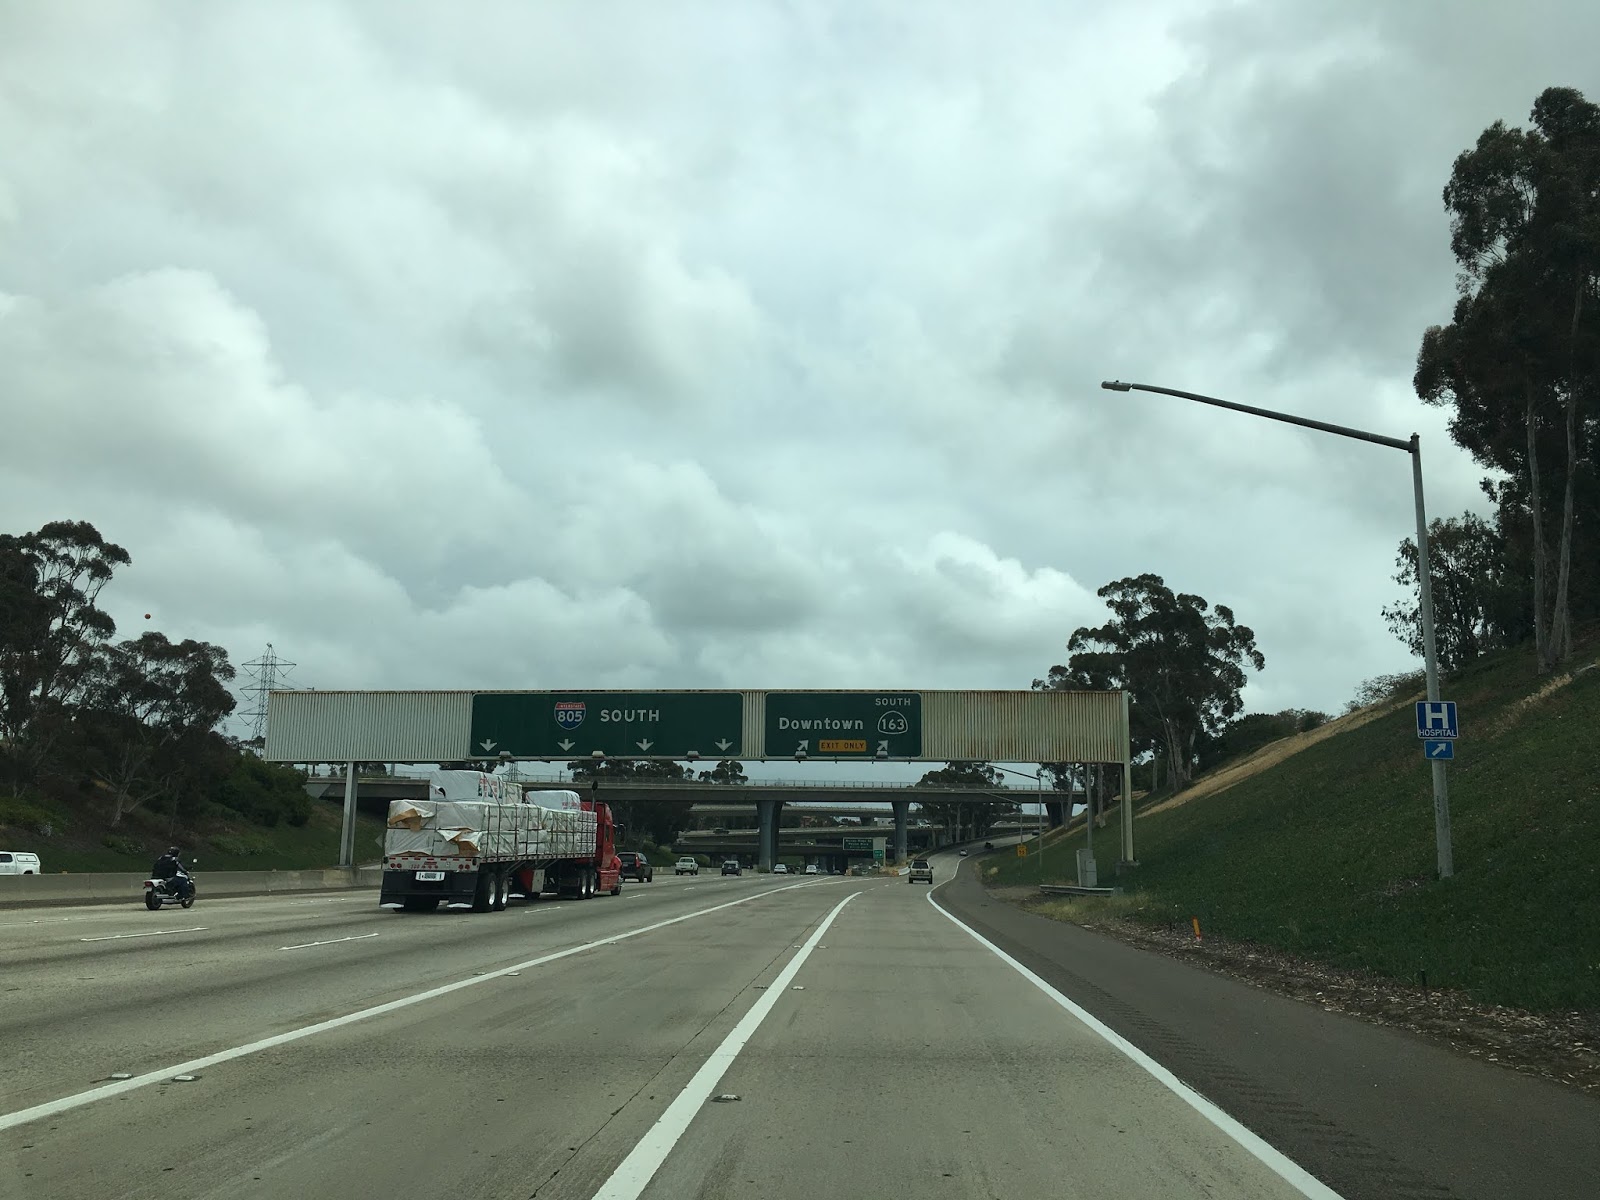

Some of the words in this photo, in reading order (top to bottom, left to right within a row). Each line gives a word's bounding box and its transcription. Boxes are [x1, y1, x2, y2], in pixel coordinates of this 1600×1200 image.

[875, 698, 911, 706] SOUTH
[557, 710, 583, 722] 805
[600, 709, 660, 722] SOUTH
[1425, 703, 1449, 729] H
[779, 717, 864, 730] Downtown
[881, 718, 905, 730] 163
[1419, 729, 1457, 737] HOSPITAL
